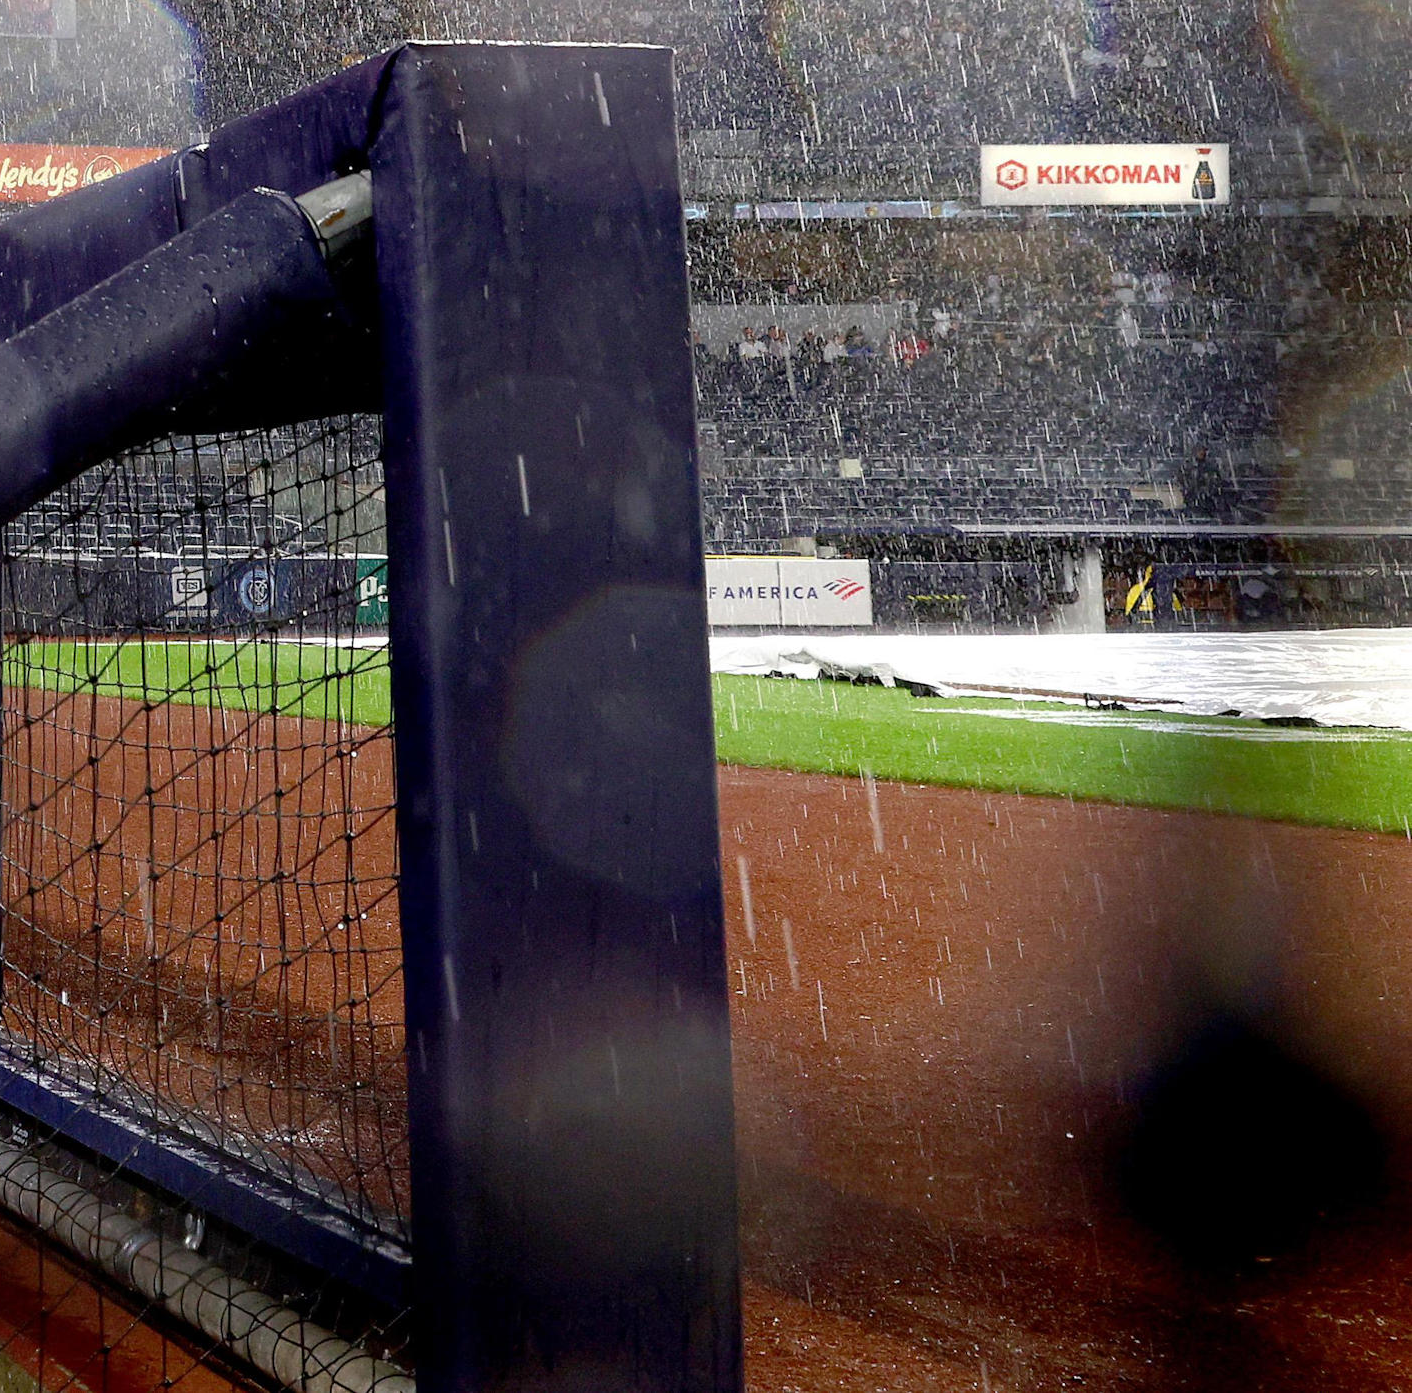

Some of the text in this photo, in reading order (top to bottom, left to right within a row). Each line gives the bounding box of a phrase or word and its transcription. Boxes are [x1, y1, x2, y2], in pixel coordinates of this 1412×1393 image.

[1037, 164, 1181, 184] KIKKOMAN
[709, 586, 818, 599] F AMERICA
